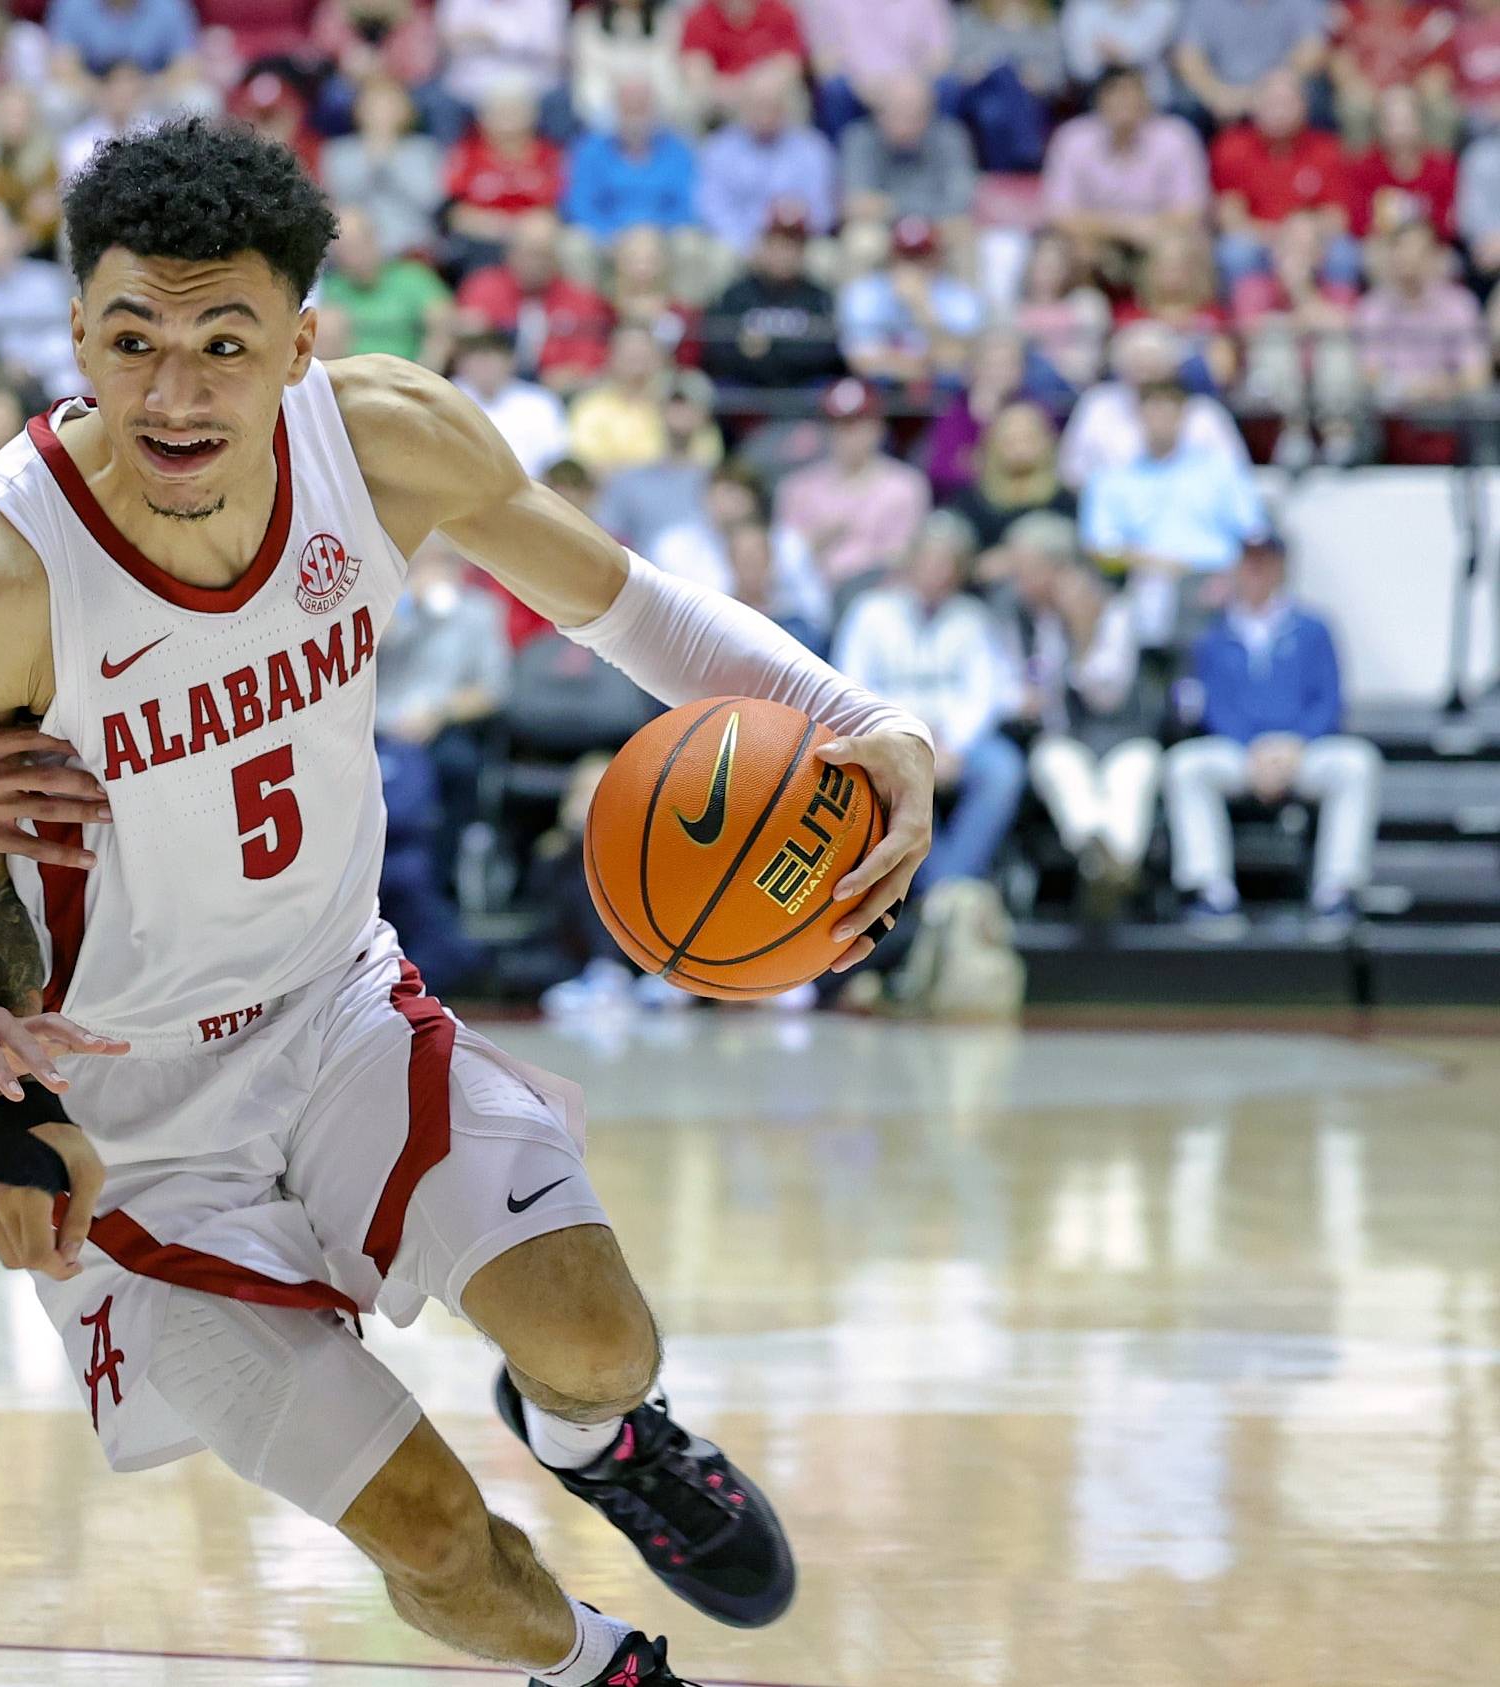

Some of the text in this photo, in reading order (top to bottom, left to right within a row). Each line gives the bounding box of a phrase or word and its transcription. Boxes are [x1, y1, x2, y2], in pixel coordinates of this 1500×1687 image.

[300, 534, 344, 595] SEC
[304, 575, 354, 612] GRADUATE
[102, 605, 375, 781] ALABAMA
[231, 743, 303, 880] 5
[753, 762, 854, 908] ELITE
